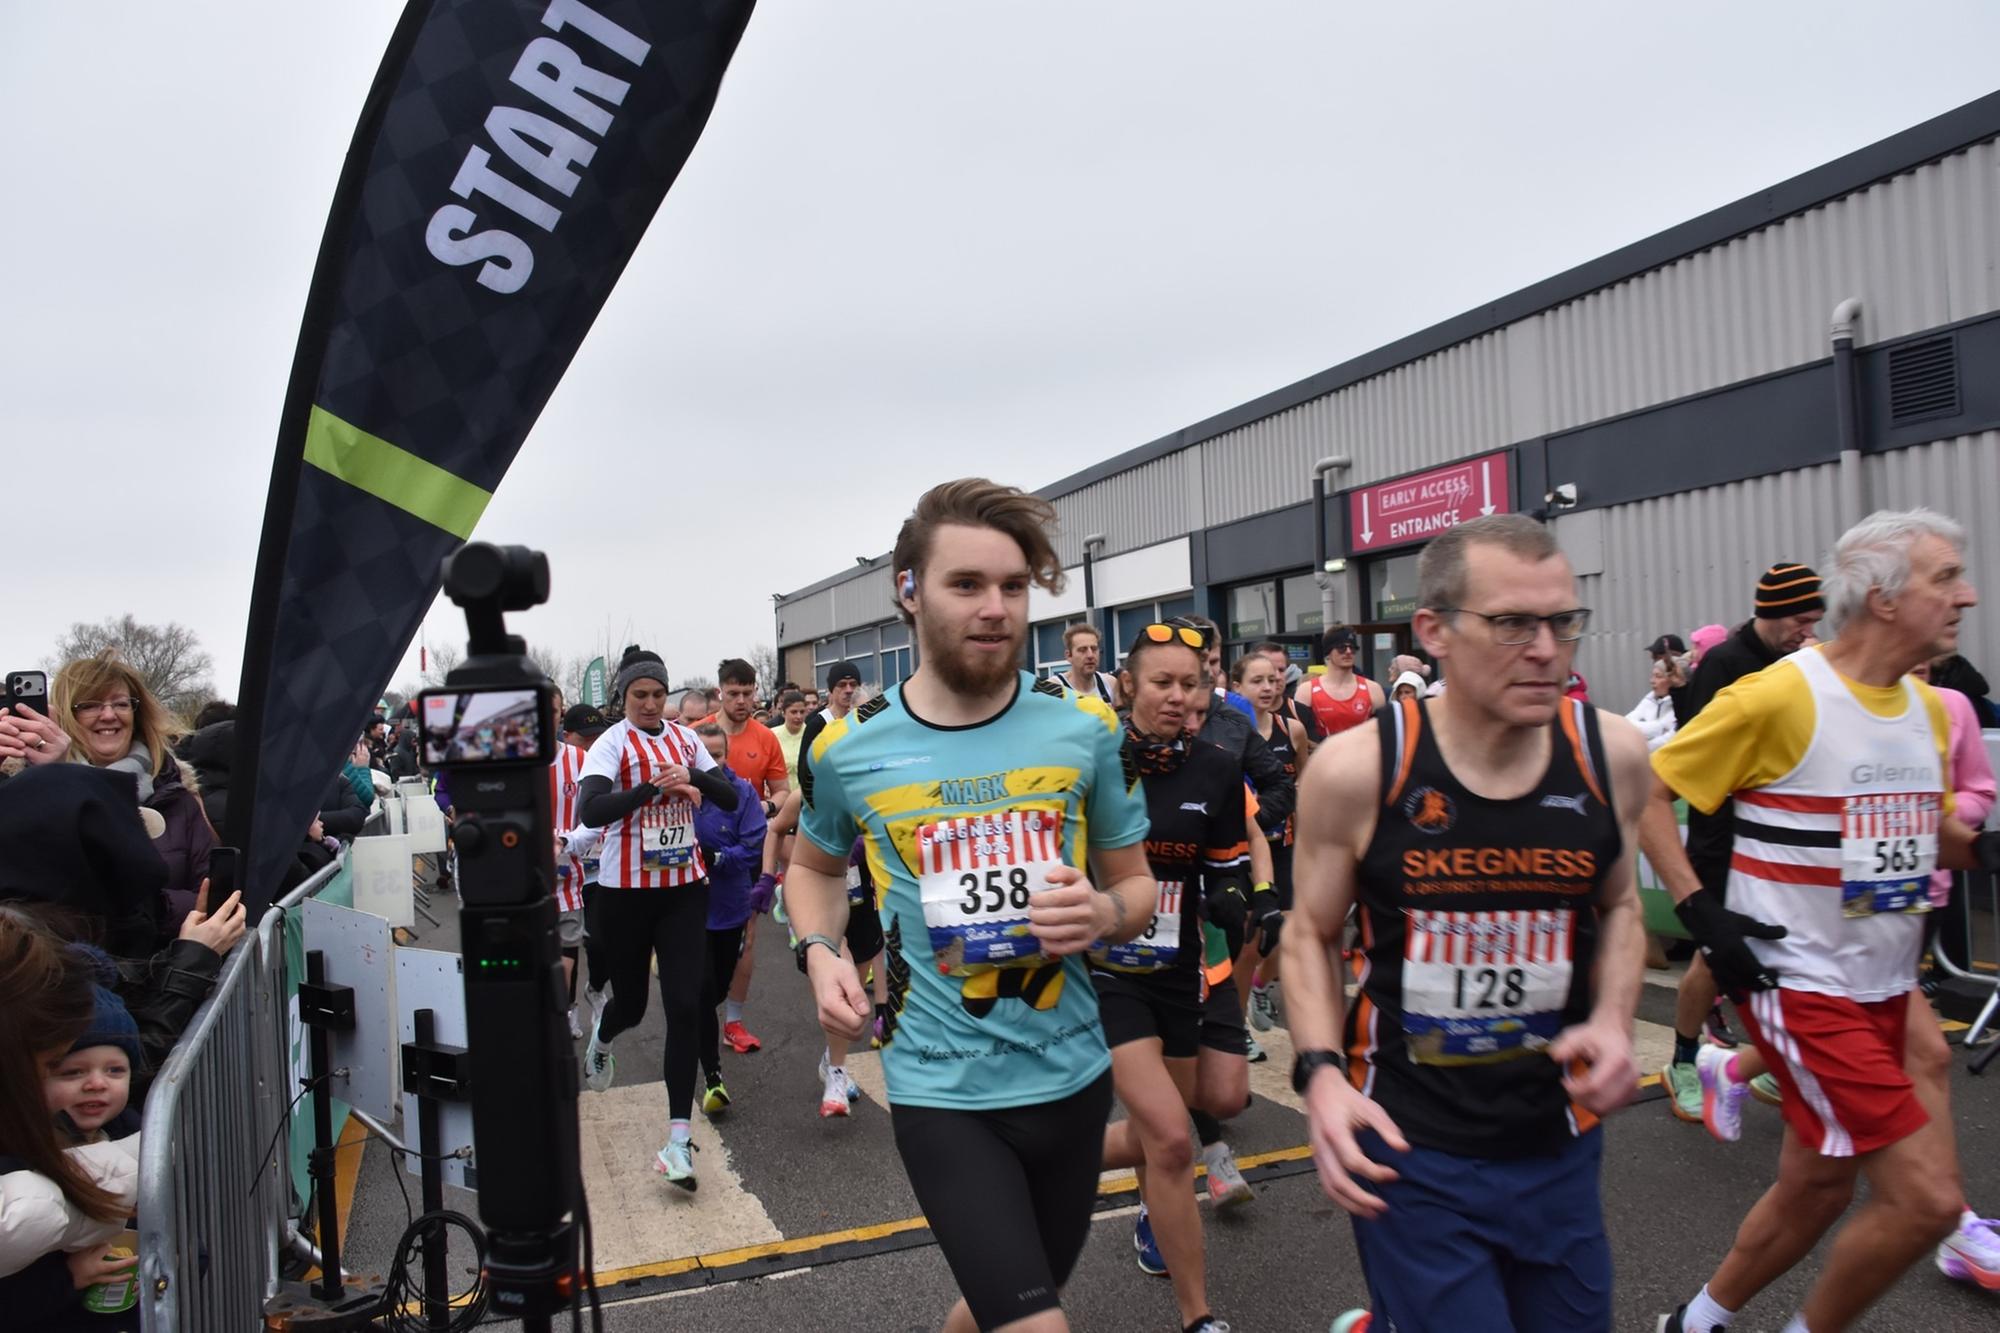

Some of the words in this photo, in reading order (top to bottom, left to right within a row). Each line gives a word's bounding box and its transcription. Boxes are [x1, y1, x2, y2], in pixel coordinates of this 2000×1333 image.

[426, 0, 652, 294] START
[1382, 488, 1417, 509] EARLY
[1420, 475, 1468, 500] ACCESS
[1390, 509, 1460, 539] ENTRANCE
[1851, 763, 1932, 785] Glenn
[940, 774, 1009, 805] MARK
[659, 826, 685, 846] 677
[1146, 840, 1198, 858] NESS
[1402, 848, 1598, 878] SKEGNESS
[1874, 839, 1919, 874] 563
[960, 867, 1030, 915] 358
[1144, 914, 1159, 941] 8
[1455, 968, 1526, 1009] 128
